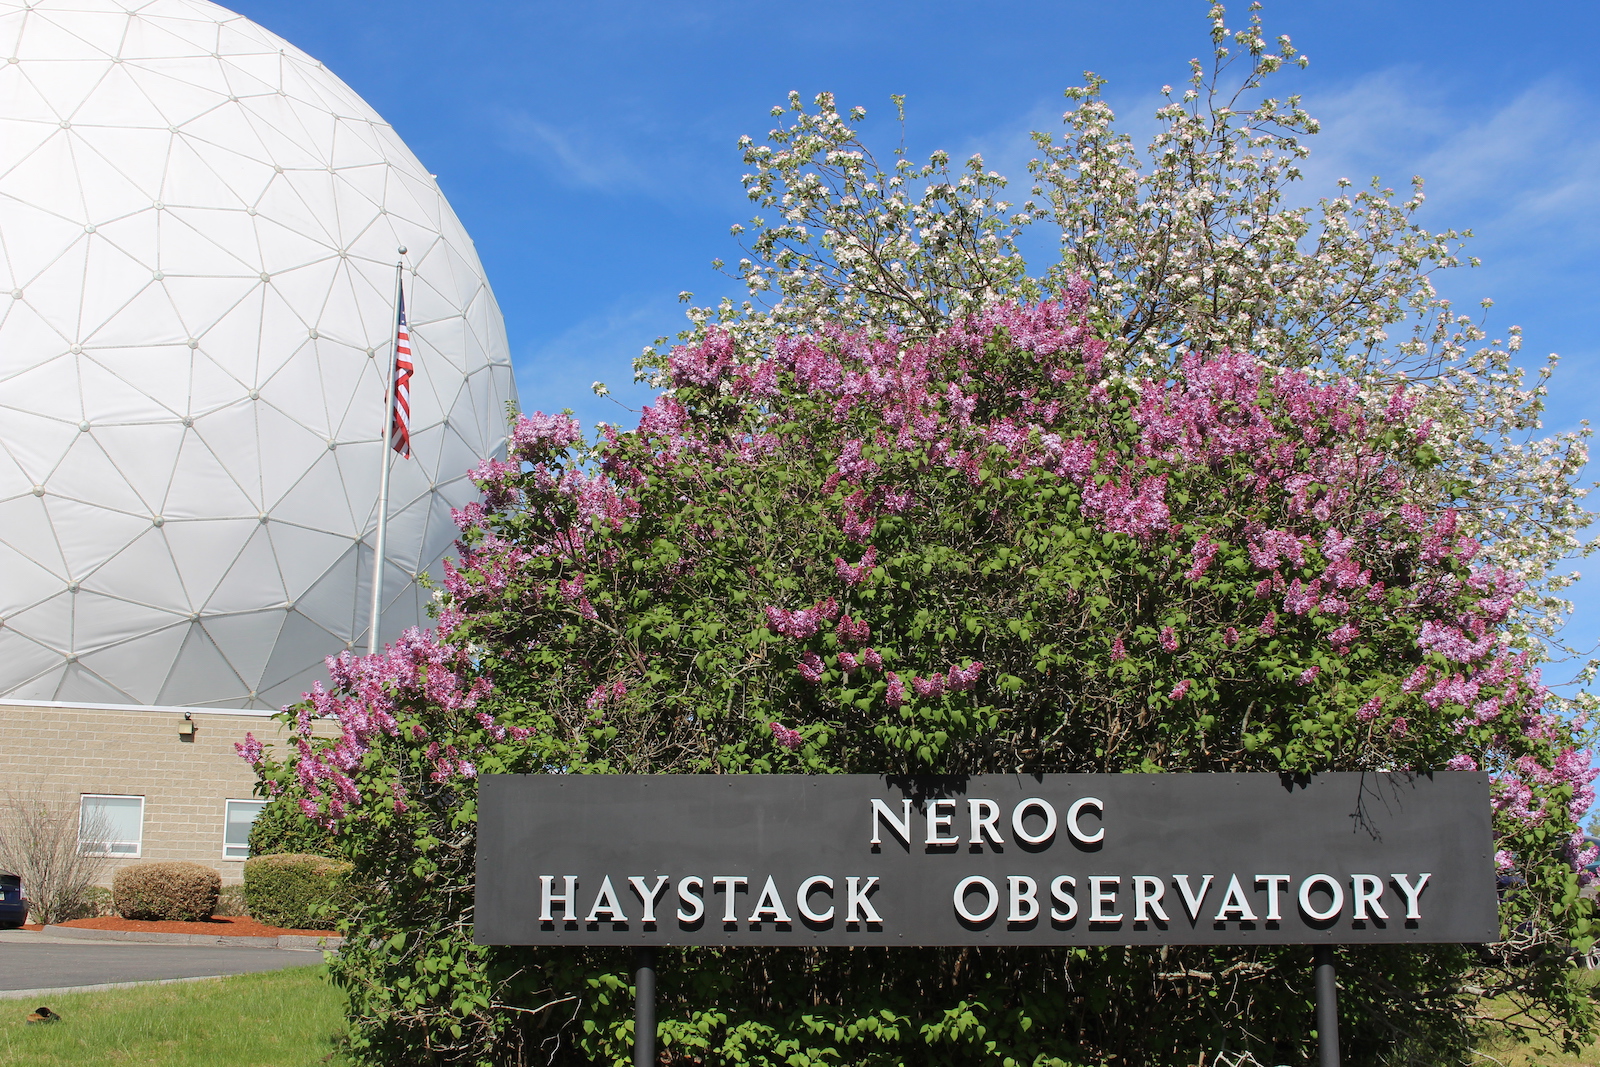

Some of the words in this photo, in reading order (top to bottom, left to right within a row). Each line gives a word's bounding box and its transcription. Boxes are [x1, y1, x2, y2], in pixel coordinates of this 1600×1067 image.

[870, 797, 1105, 845] NEROC
[538, 874, 884, 923] HAYSTACK
[953, 873, 1432, 923] OBSERVATORY
